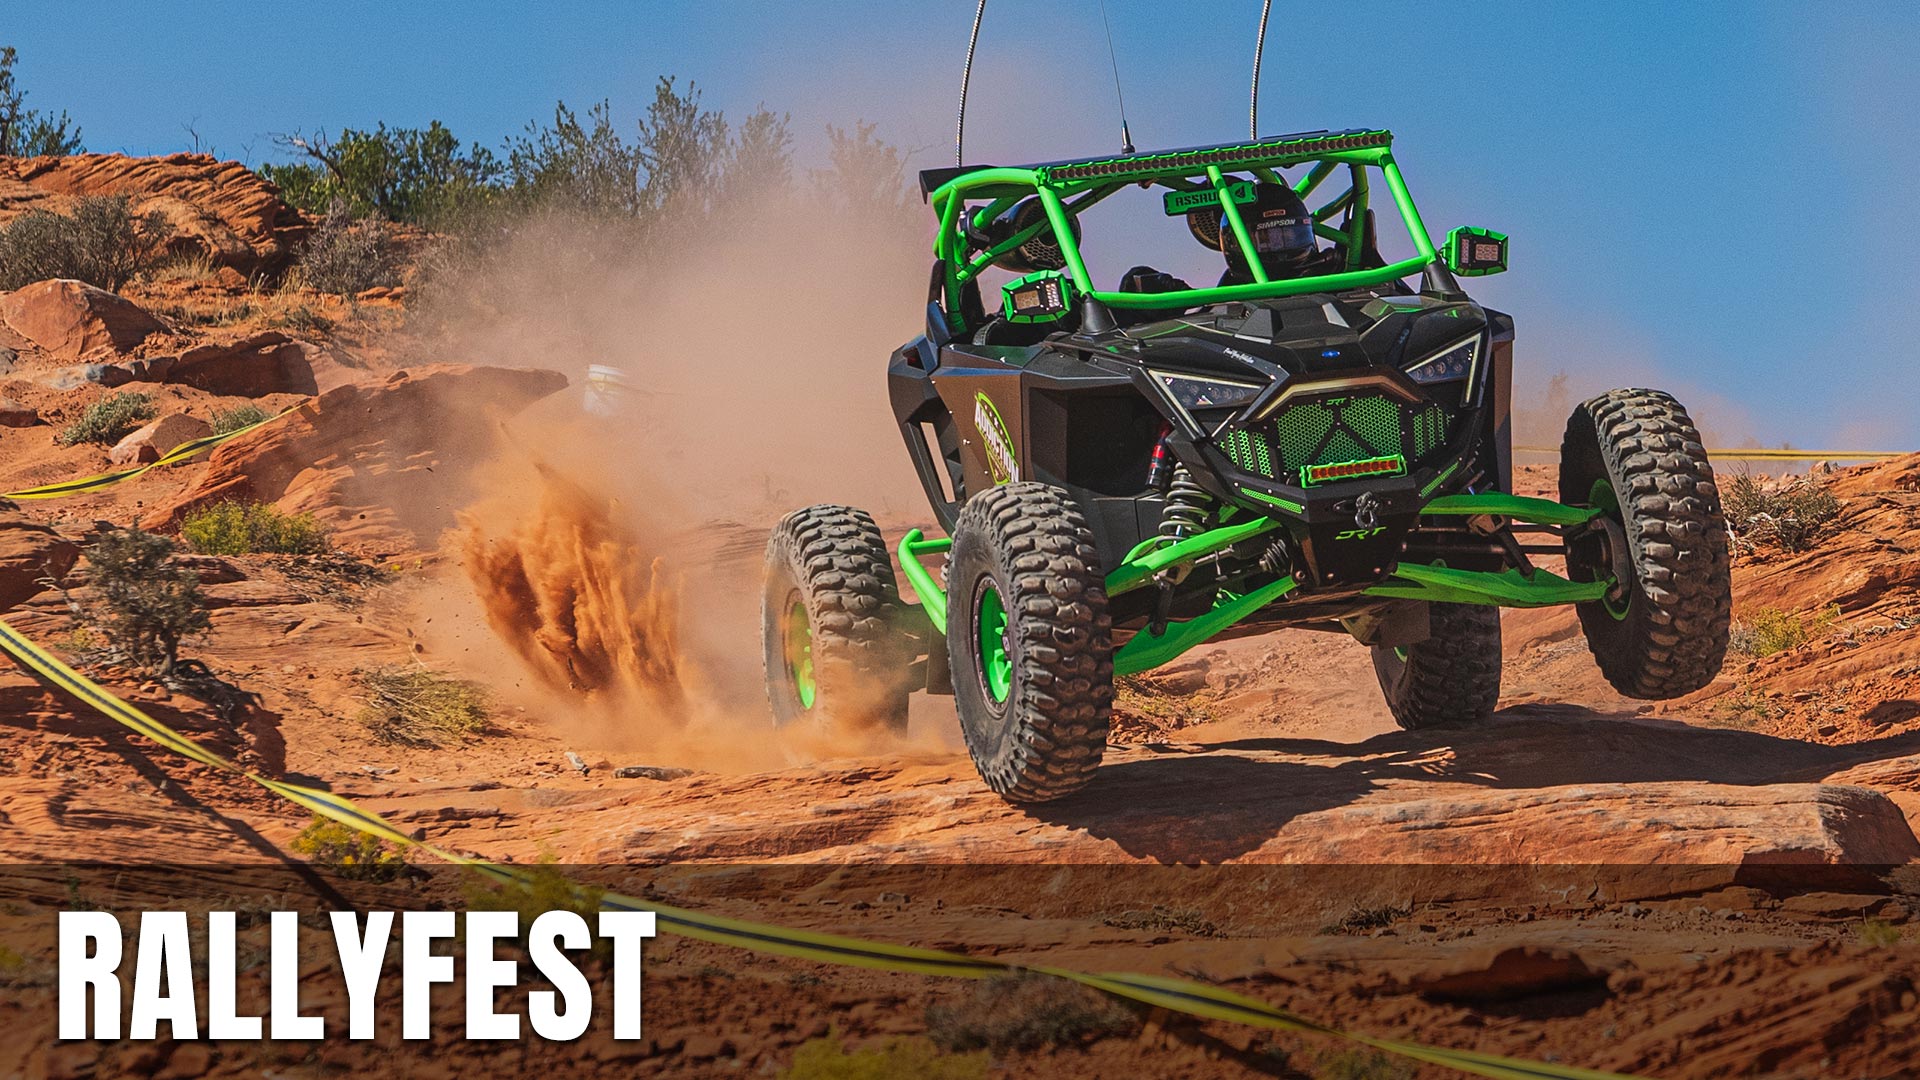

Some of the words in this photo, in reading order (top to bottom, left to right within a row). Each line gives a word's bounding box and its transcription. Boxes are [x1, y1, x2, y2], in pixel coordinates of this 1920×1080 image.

[1175, 191, 1221, 206] ASSAU
[1256, 219, 1296, 230] SIMPSON
[1335, 526, 1387, 541] DRT
